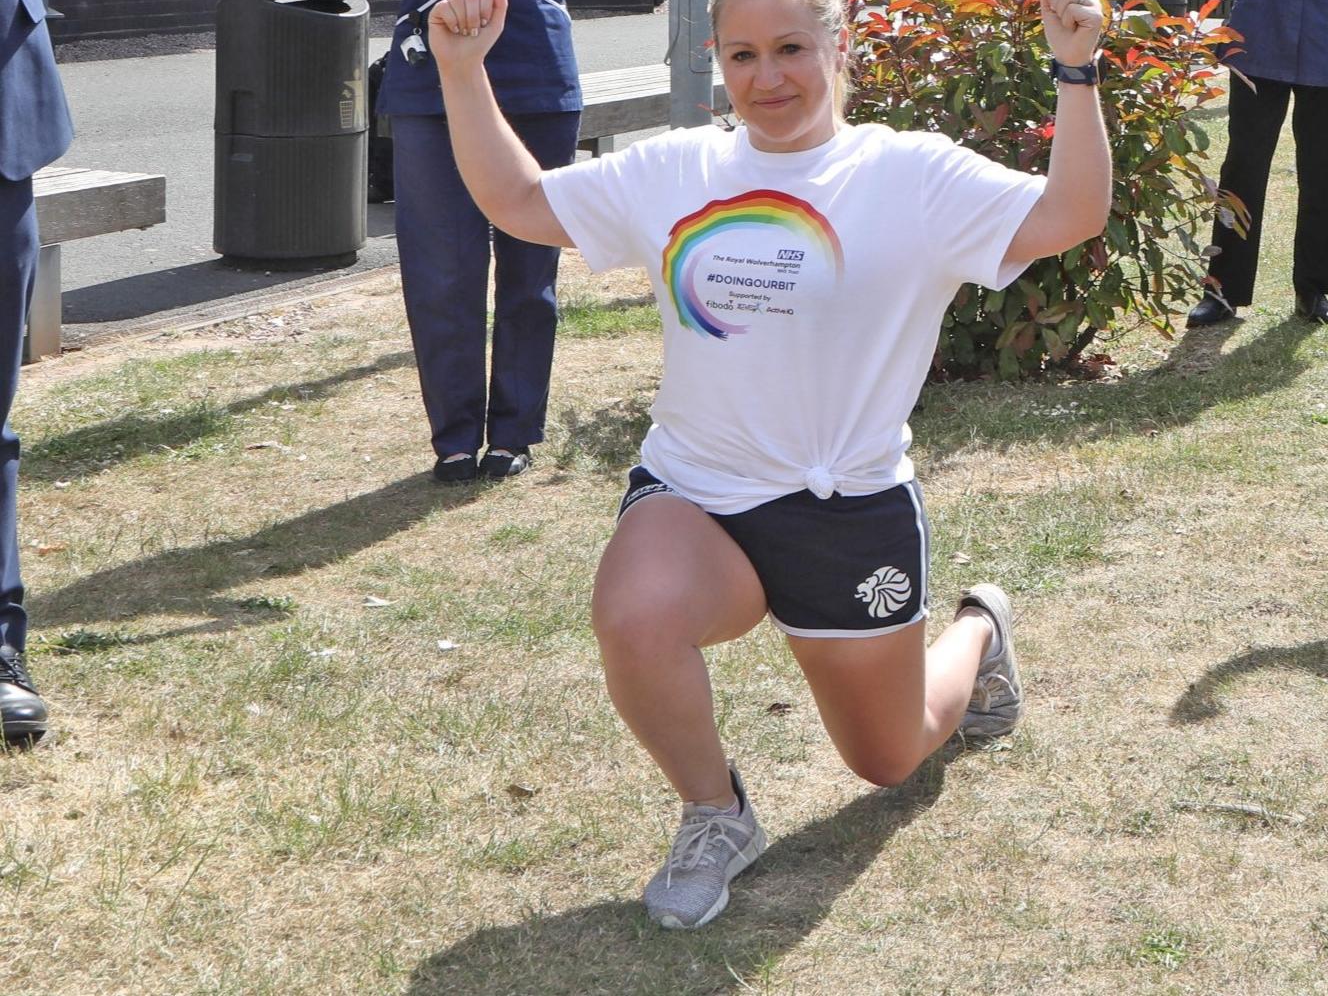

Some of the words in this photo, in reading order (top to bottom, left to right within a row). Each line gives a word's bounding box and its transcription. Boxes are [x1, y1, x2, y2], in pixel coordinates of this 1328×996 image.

[777, 250, 804, 261] NHS
[726, 256, 745, 264] Royal
[746, 258, 801, 269] Wolverhampton
[706, 273, 797, 291] #DOINGOURBIT
[728, 290, 762, 300] Supported
[763, 294, 771, 302] by
